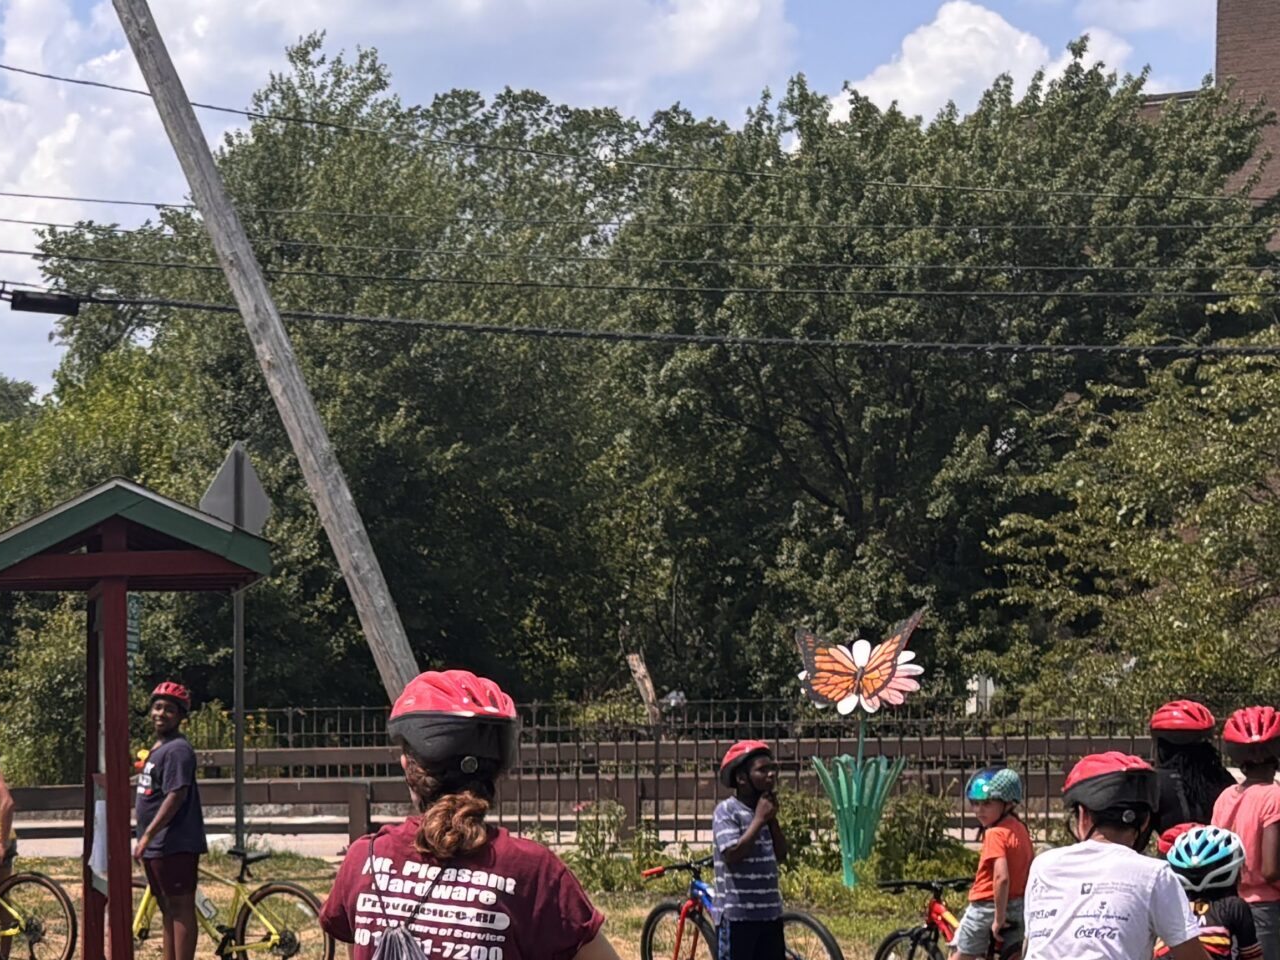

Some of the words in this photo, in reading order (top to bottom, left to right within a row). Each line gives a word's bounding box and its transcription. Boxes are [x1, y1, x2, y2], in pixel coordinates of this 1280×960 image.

[362, 855, 397, 875] Mt.
[402, 860, 516, 895] Pleasant
[372, 874, 497, 905] Hardware
[454, 930, 505, 942] Service
